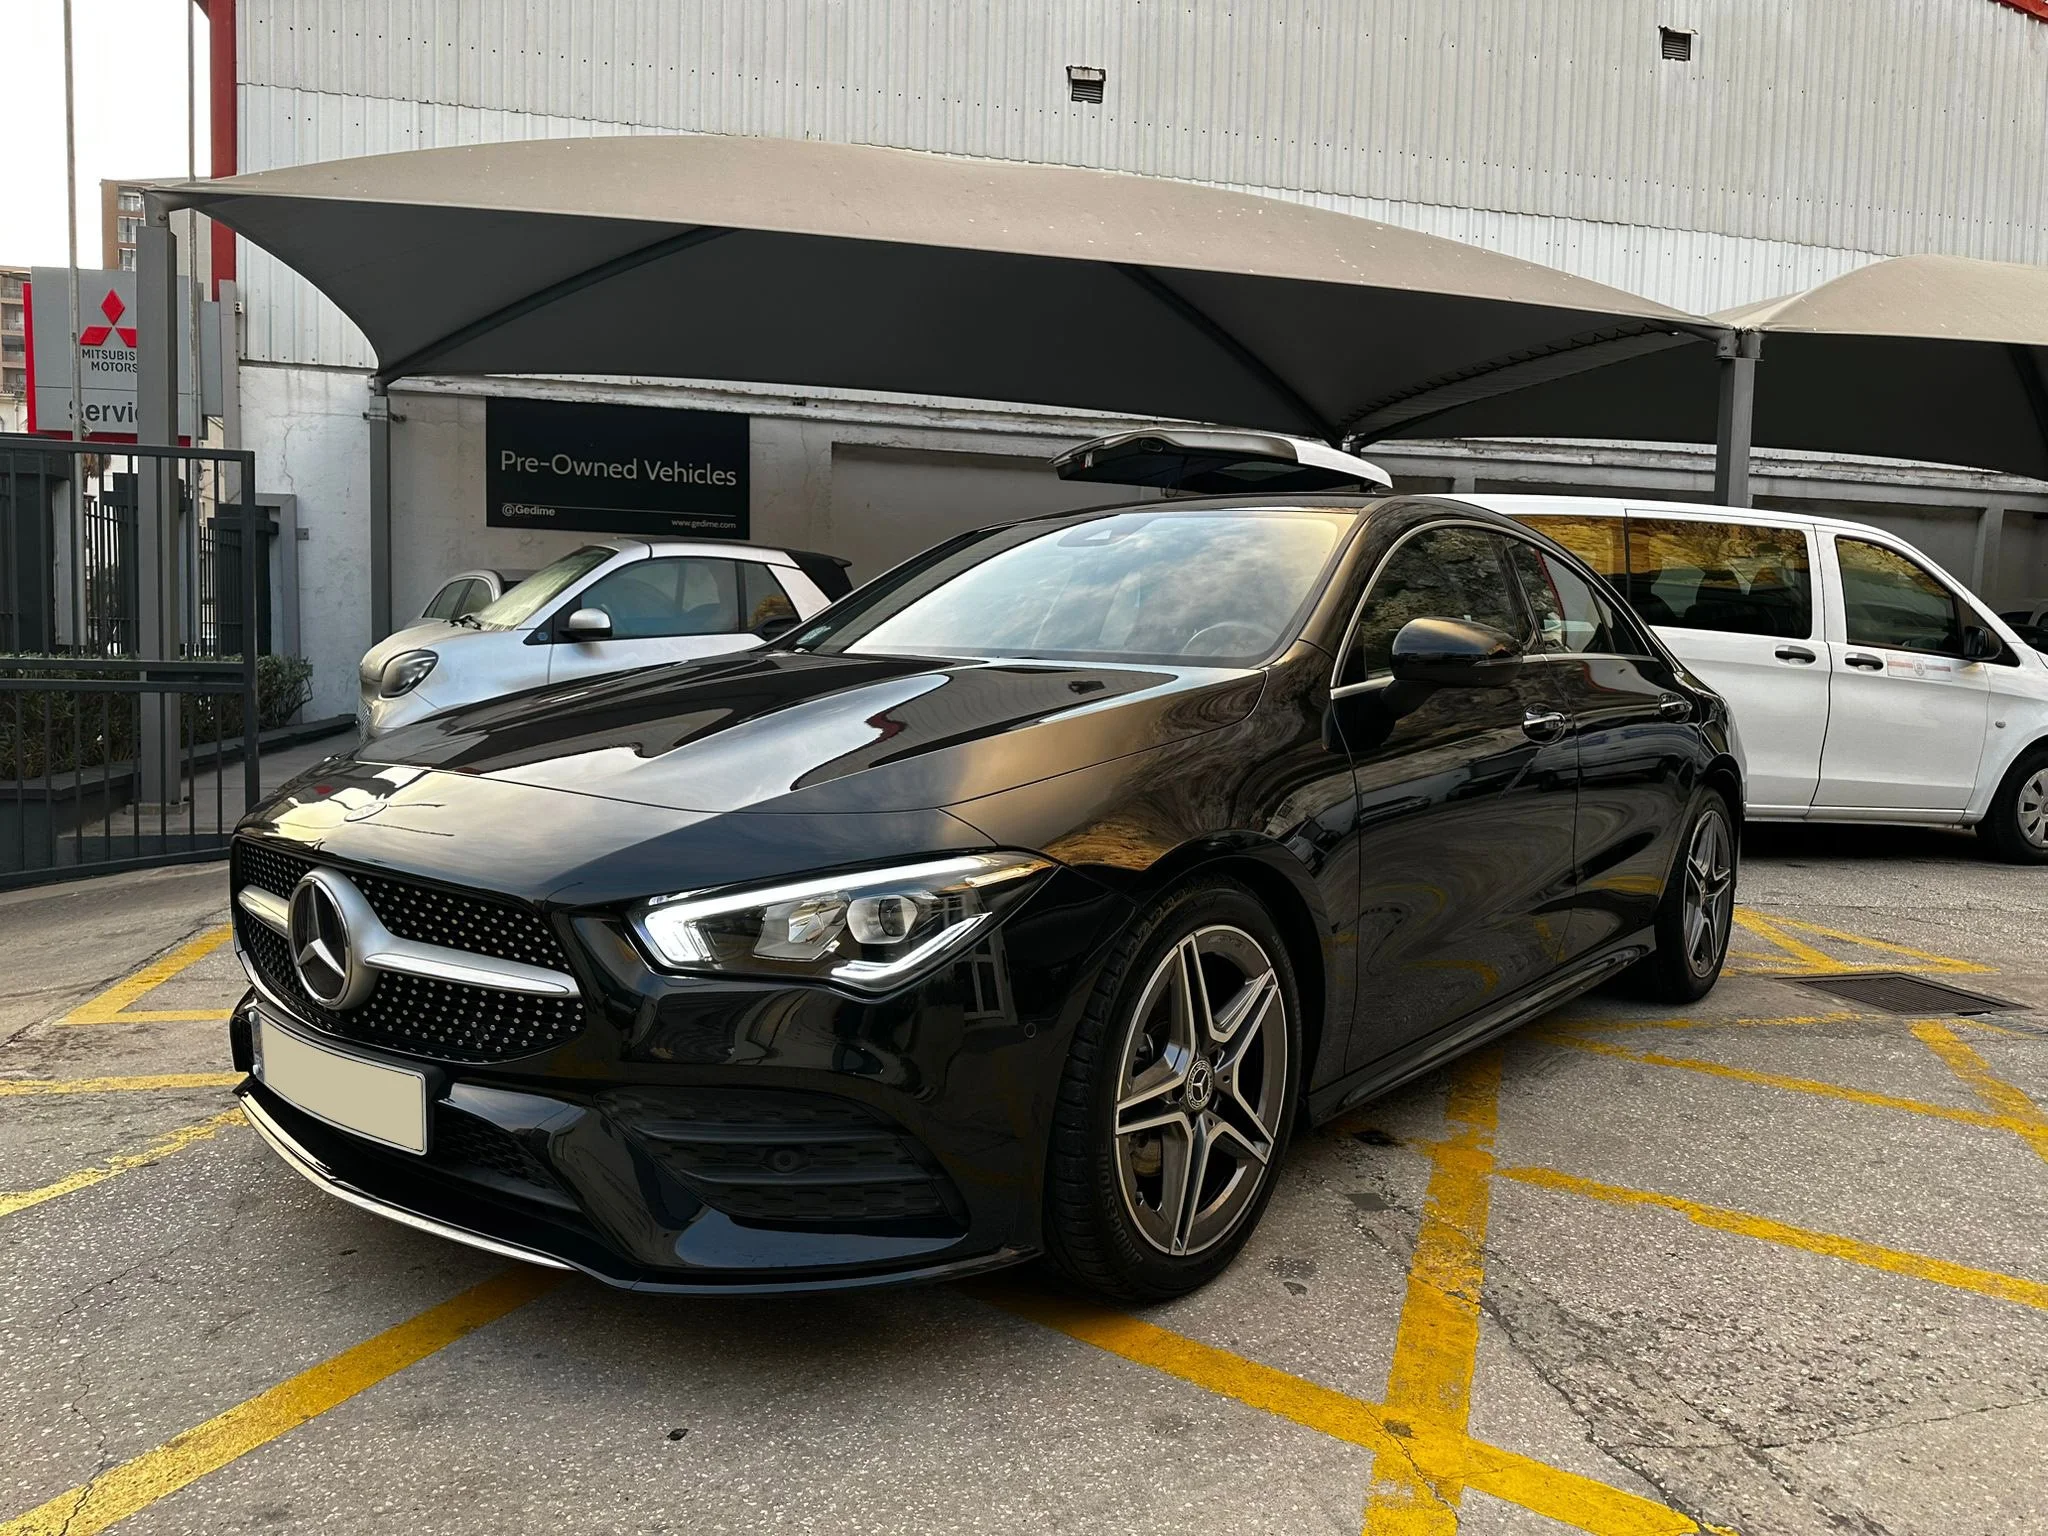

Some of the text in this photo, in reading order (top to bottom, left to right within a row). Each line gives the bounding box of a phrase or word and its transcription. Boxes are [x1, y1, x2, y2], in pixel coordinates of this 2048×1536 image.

[81, 349, 136, 361] MITSUBIS
[68, 400, 138, 423] ervi
[500, 450, 737, 486] Pre-Owned Vehicles
[671, 519, 737, 529] www.gedime.com
